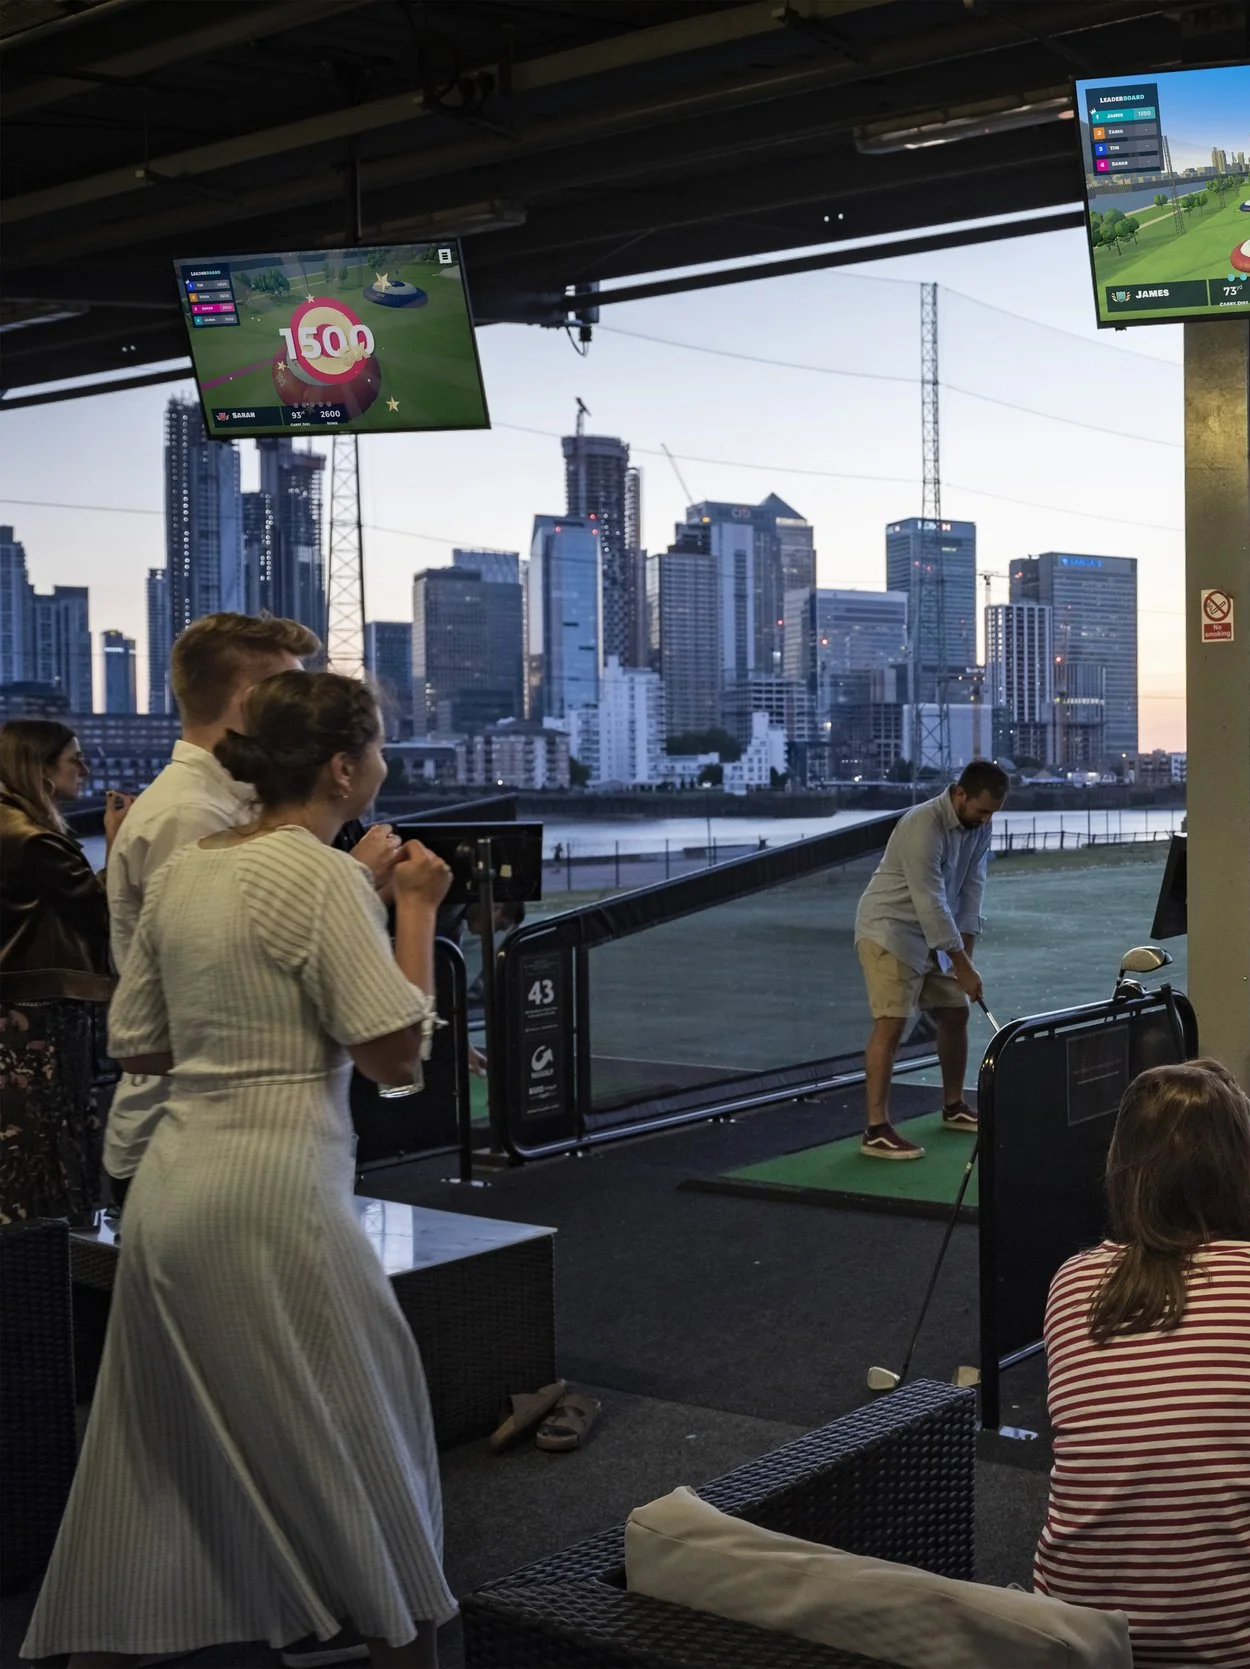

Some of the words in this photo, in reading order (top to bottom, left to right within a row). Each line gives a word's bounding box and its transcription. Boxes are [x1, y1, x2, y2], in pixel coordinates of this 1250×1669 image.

[1100, 94, 1145, 103] LEADERBOARD
[1135, 288, 1170, 299] JAMES
[279, 324, 375, 360] 1500
[320, 410, 341, 418] 2600
[527, 979, 555, 1005] 43
